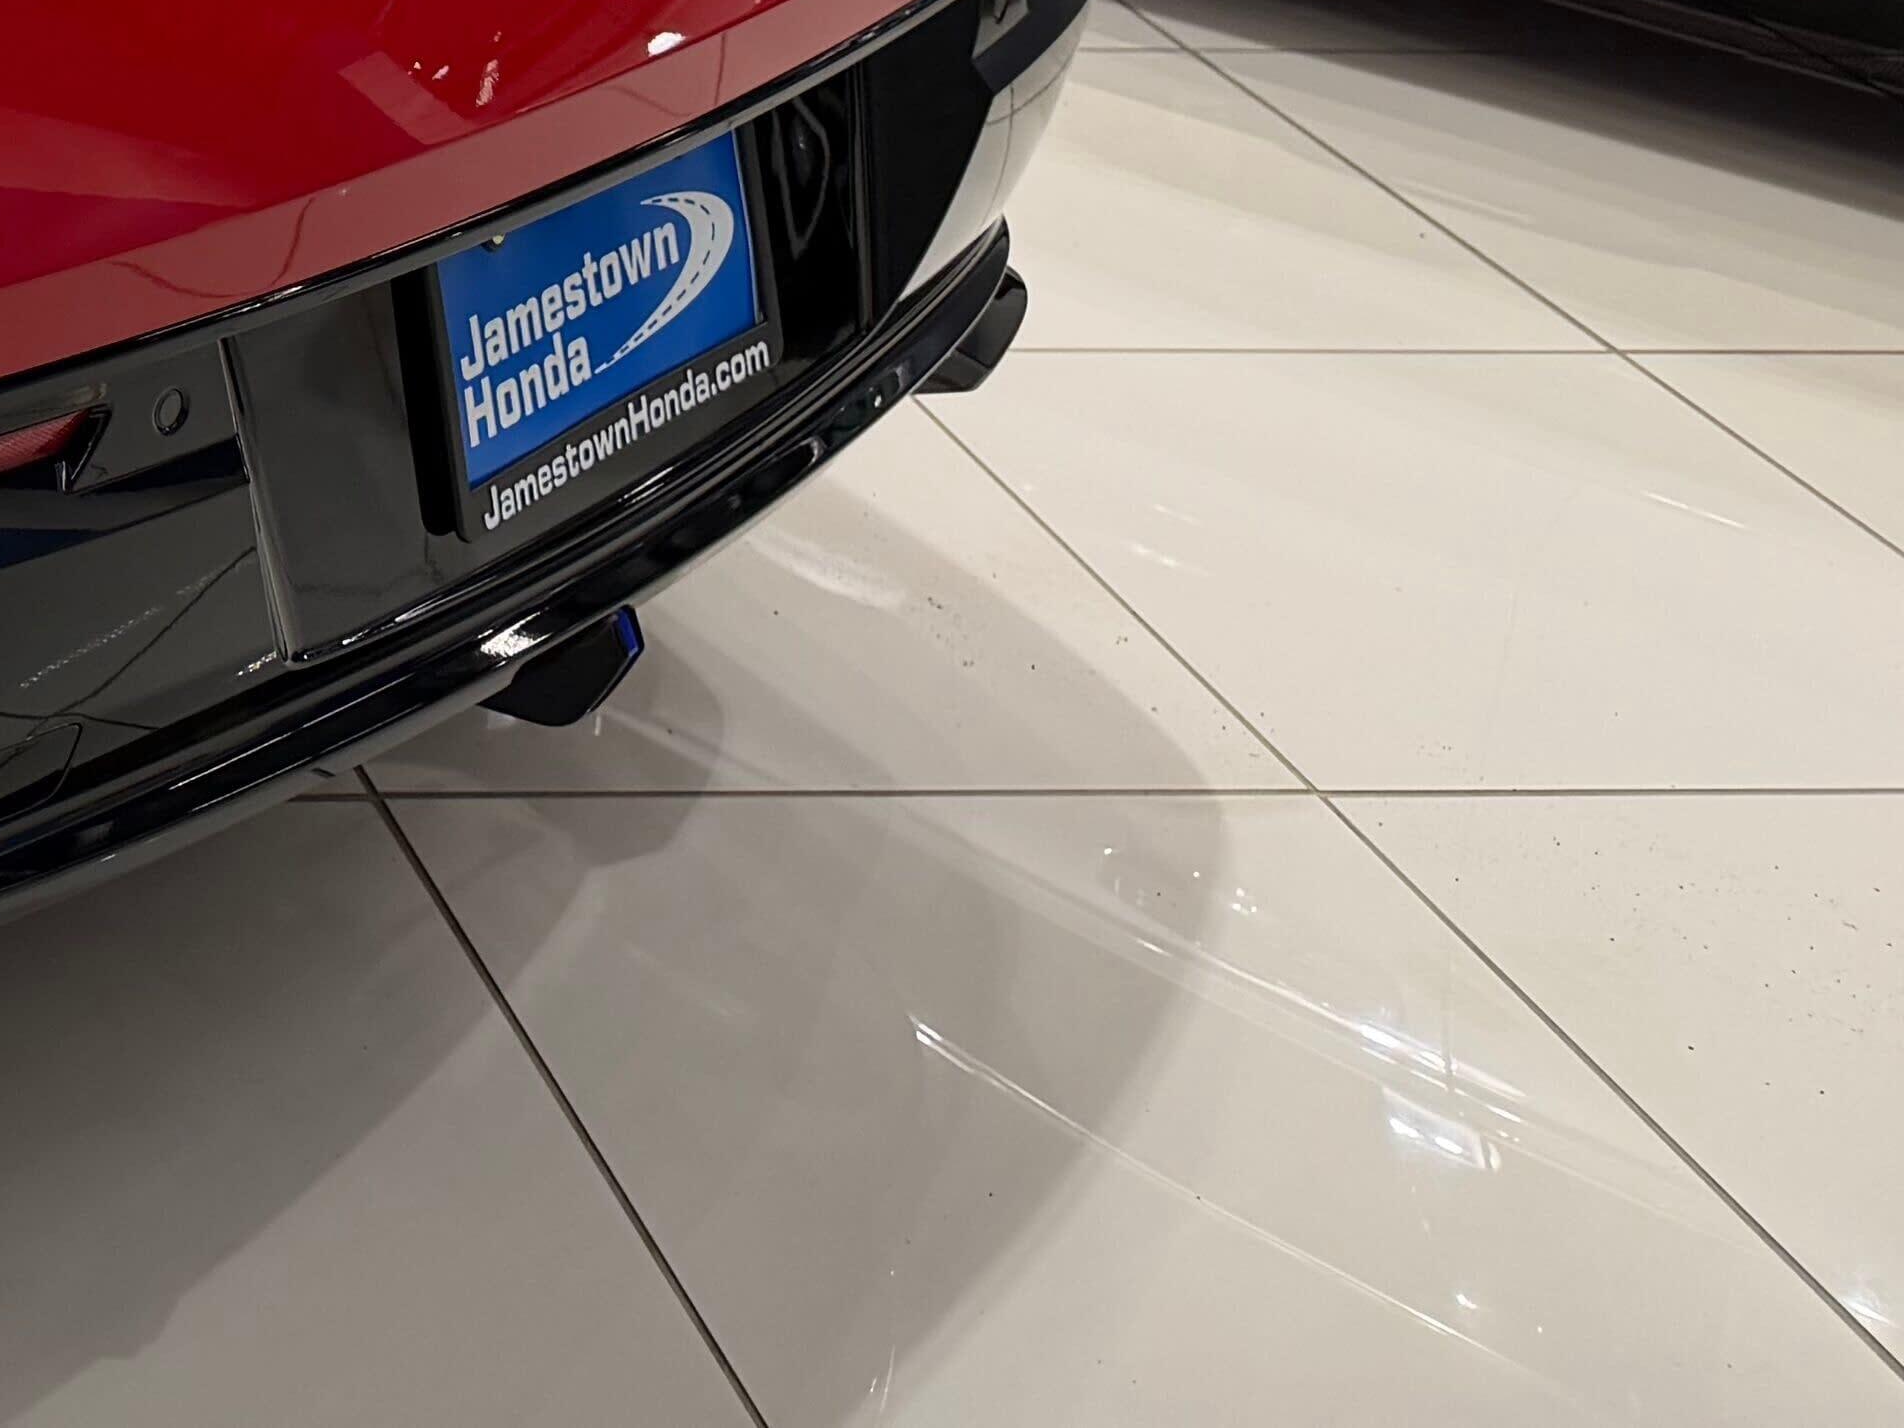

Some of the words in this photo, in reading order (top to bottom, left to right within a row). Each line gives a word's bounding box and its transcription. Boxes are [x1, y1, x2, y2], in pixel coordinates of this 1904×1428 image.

[459, 221, 680, 381] Jamestown
[463, 333, 592, 448] Honda
[483, 338, 770, 531] JamestownHonda.com
